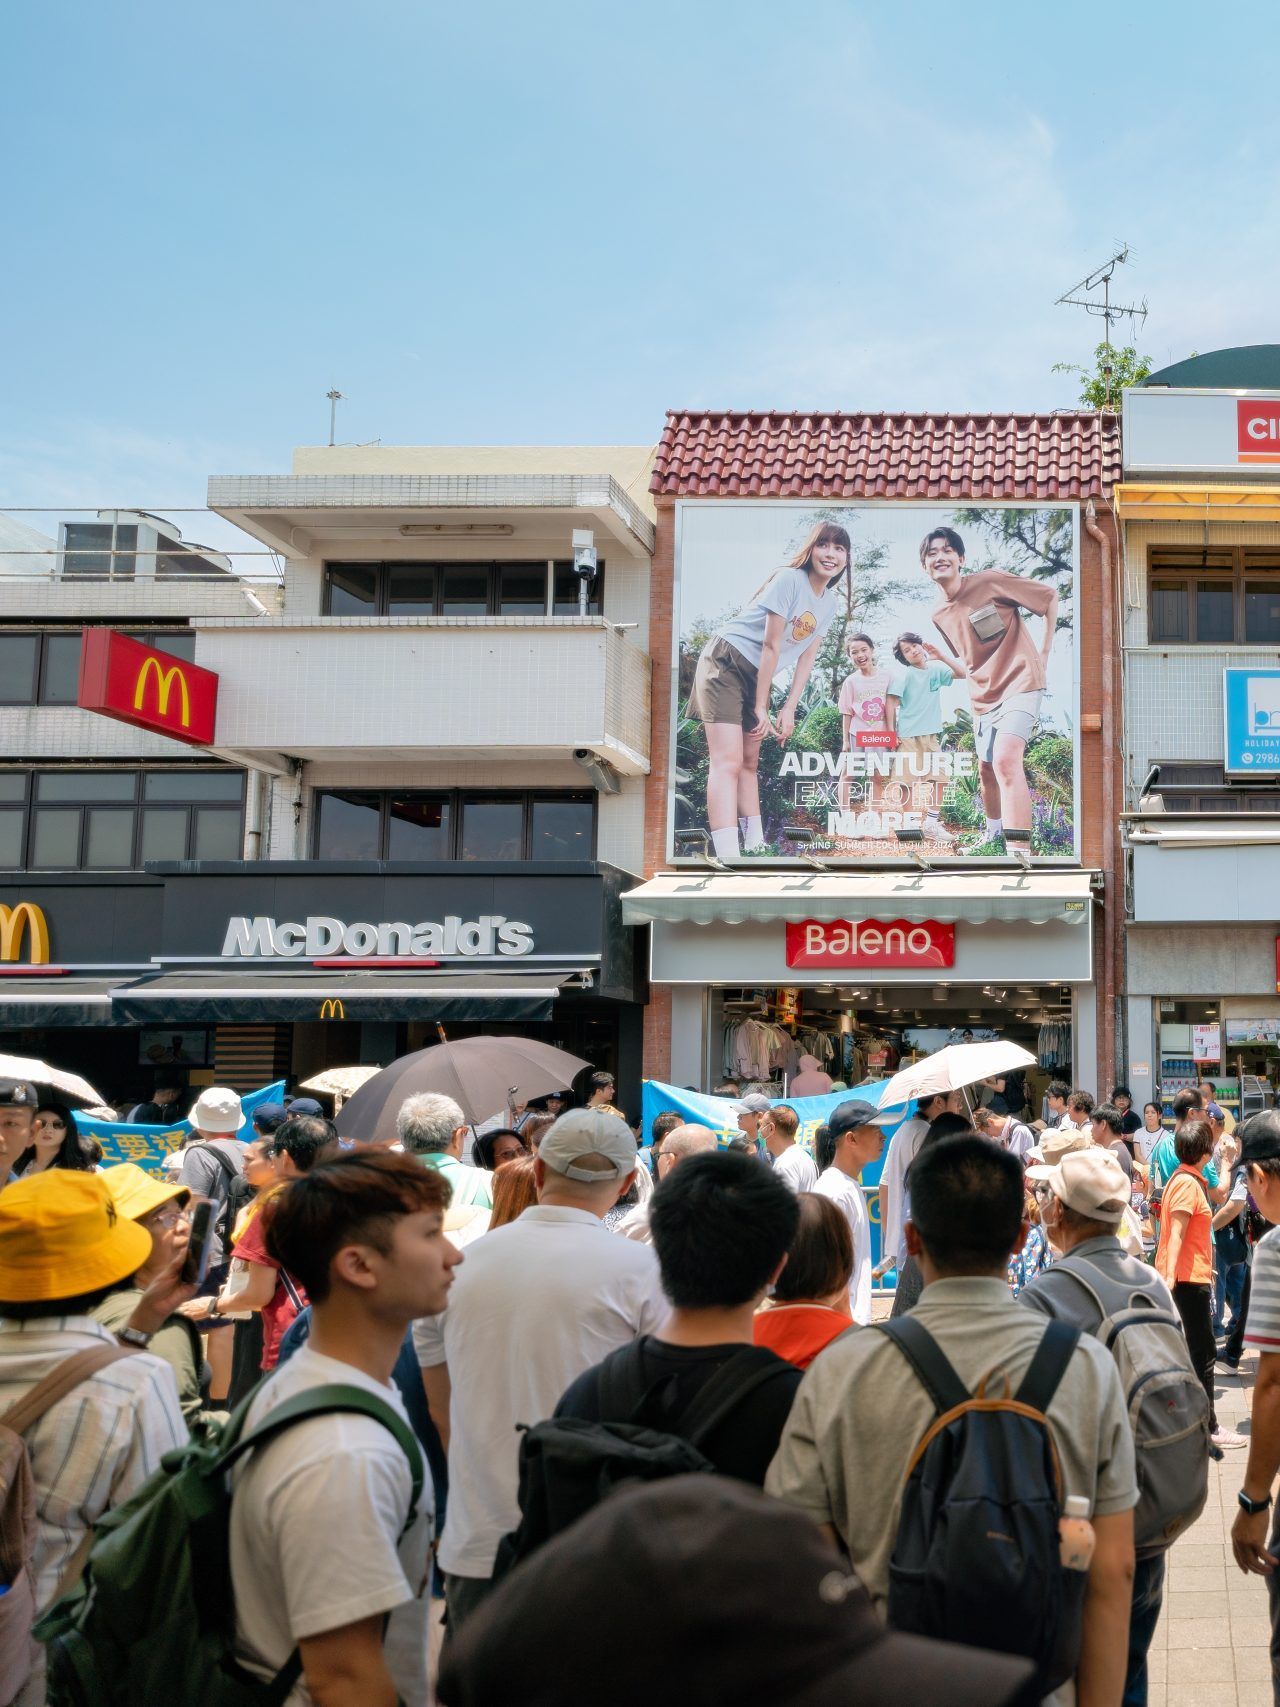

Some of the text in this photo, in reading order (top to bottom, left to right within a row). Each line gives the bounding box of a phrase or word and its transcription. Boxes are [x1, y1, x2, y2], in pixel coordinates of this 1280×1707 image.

[862, 735, 891, 743] Baleno
[778, 751, 973, 777] ADVENTURE
[1255, 753, 1279, 764] 2986
[794, 781, 957, 807] EXPLORE
[827, 811, 922, 836] MORE
[797, 841, 953, 850] SPRING SUMMER COLLECTION 2024
[221, 915, 534, 957] McDonald's
[805, 925, 931, 955] Baleno
